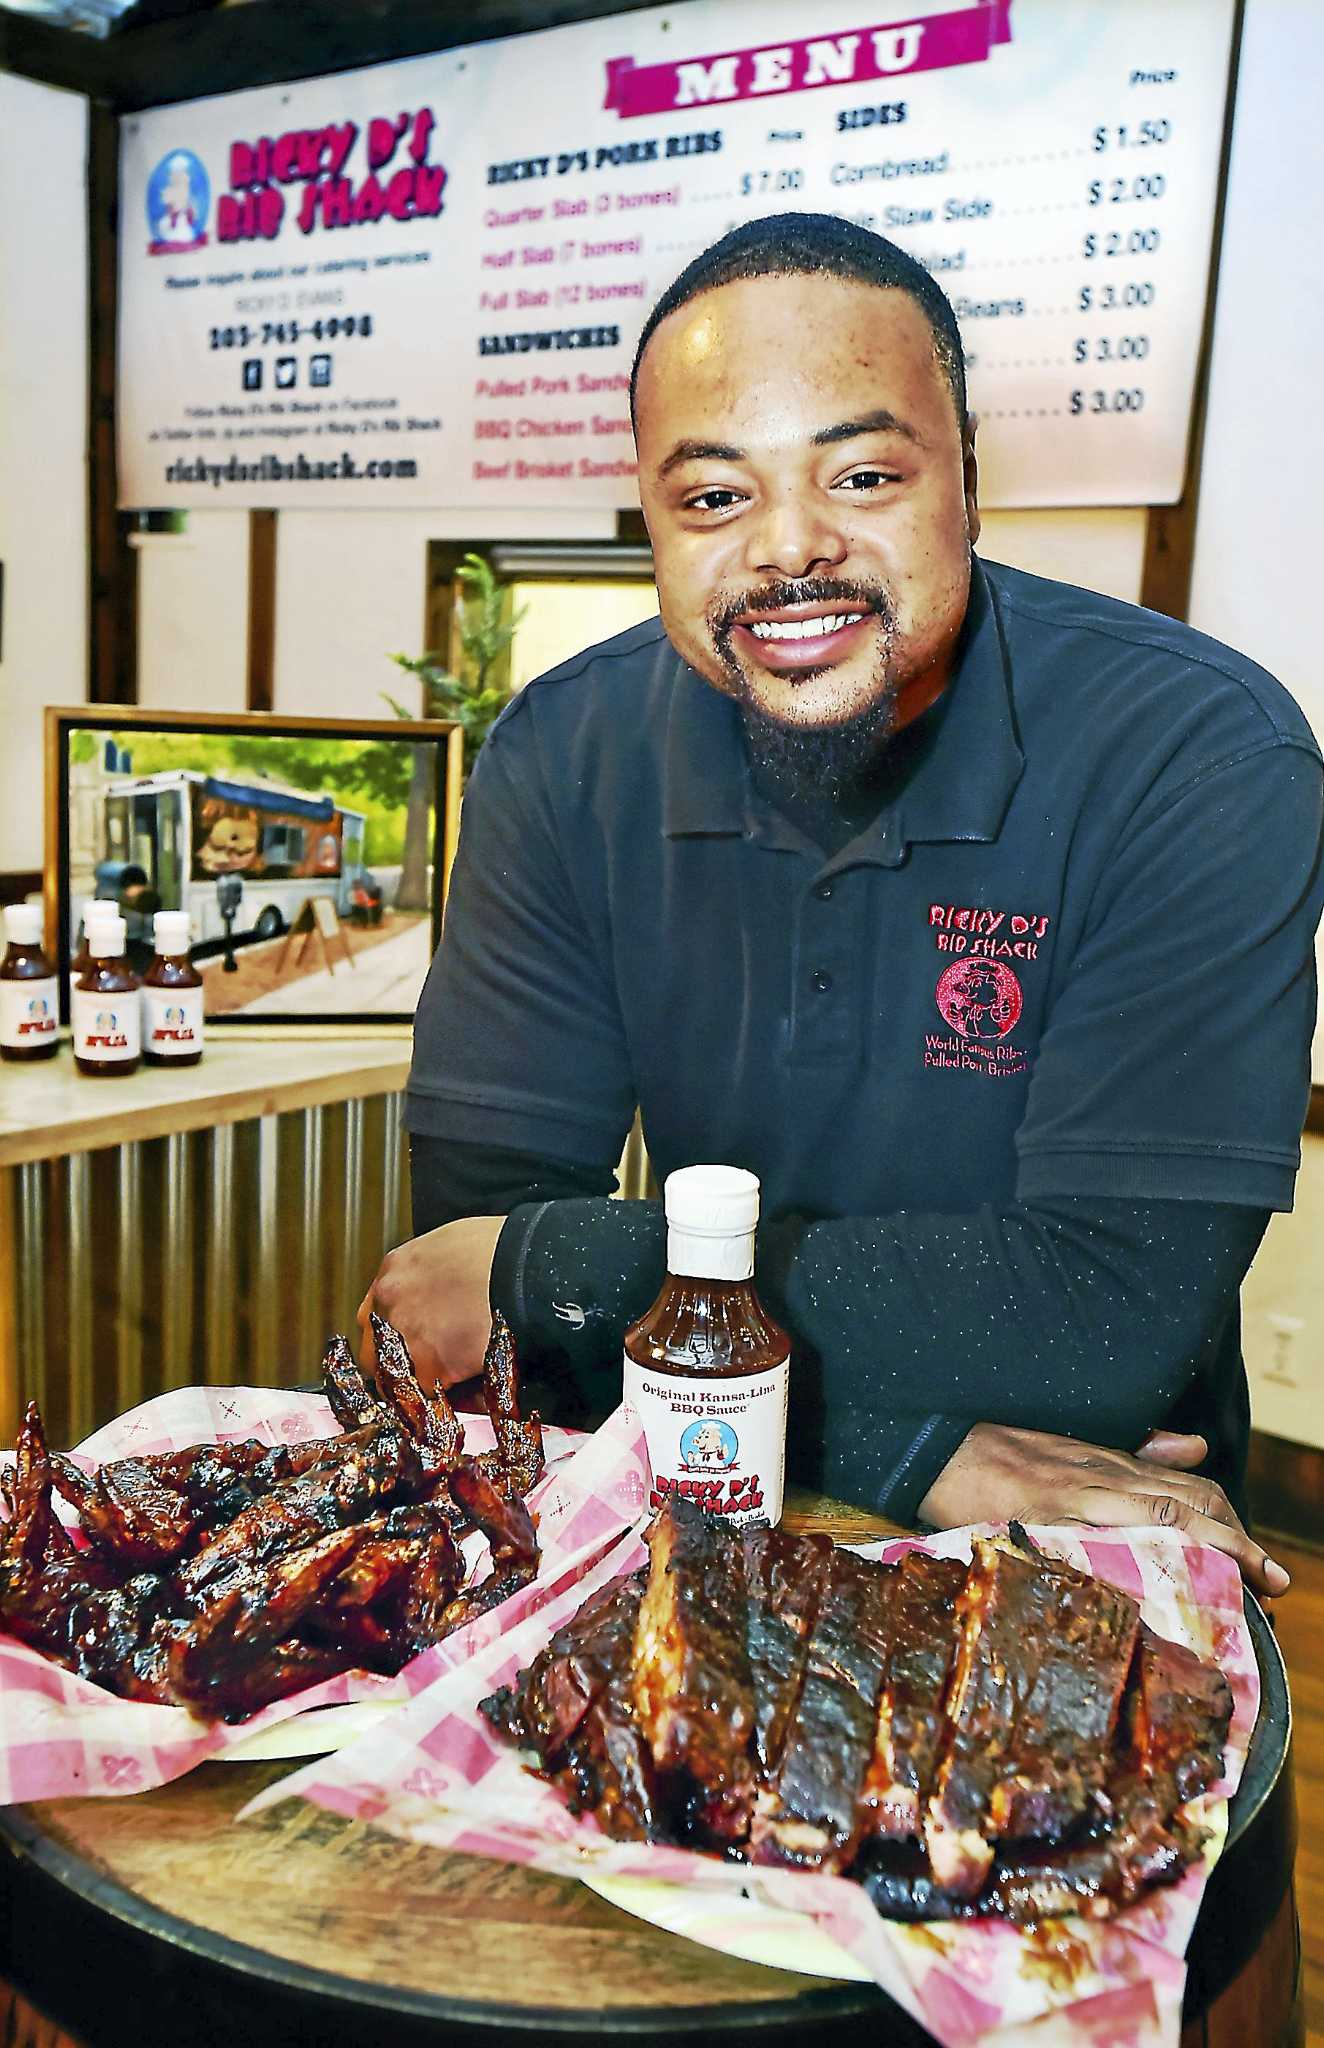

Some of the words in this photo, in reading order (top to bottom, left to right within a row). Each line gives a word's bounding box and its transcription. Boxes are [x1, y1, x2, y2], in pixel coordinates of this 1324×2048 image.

[674, 25, 925, 105] MENU
[1129, 69, 1177, 88] Price
[835, 100, 907, 132] SIDES
[229, 120, 358, 190] RICKY
[367, 106, 436, 169] D'S
[486, 156, 551, 186] RICKY
[556, 149, 590, 175] D'S
[595, 138, 658, 169] PORK
[665, 130, 723, 158] RIBS
[830, 150, 951, 187] Cornbread
[216, 187, 286, 243] RIB
[297, 165, 448, 235] SHACK
[483, 204, 546, 229] Quarter
[552, 197, 589, 219] Slab
[942, 197, 994, 223] Side
[521, 244, 555, 266] Slab
[515, 286, 549, 308] Slab
[479, 325, 620, 356] SANDWICHES
[475, 377, 526, 397] Pulled
[532, 374, 570, 395] Pork
[474, 419, 511, 440] BBQ
[515, 417, 586, 438] Chicken
[472, 460, 511, 480] Beef
[928, 904, 1005, 936] RICKY
[936, 933, 968, 953] RIB
[970, 938, 1039, 961] SHACK
[925, 1034, 960, 1052] World
[924, 1052, 960, 1069] Pulled
[642, 1382, 697, 1402] Original
[699, 1383, 777, 1403] Kansa-Lina
[670, 1402, 705, 1416] BBQ
[706, 1404, 748, 1416] Sauce
[656, 1474, 726, 1499] RICKY
